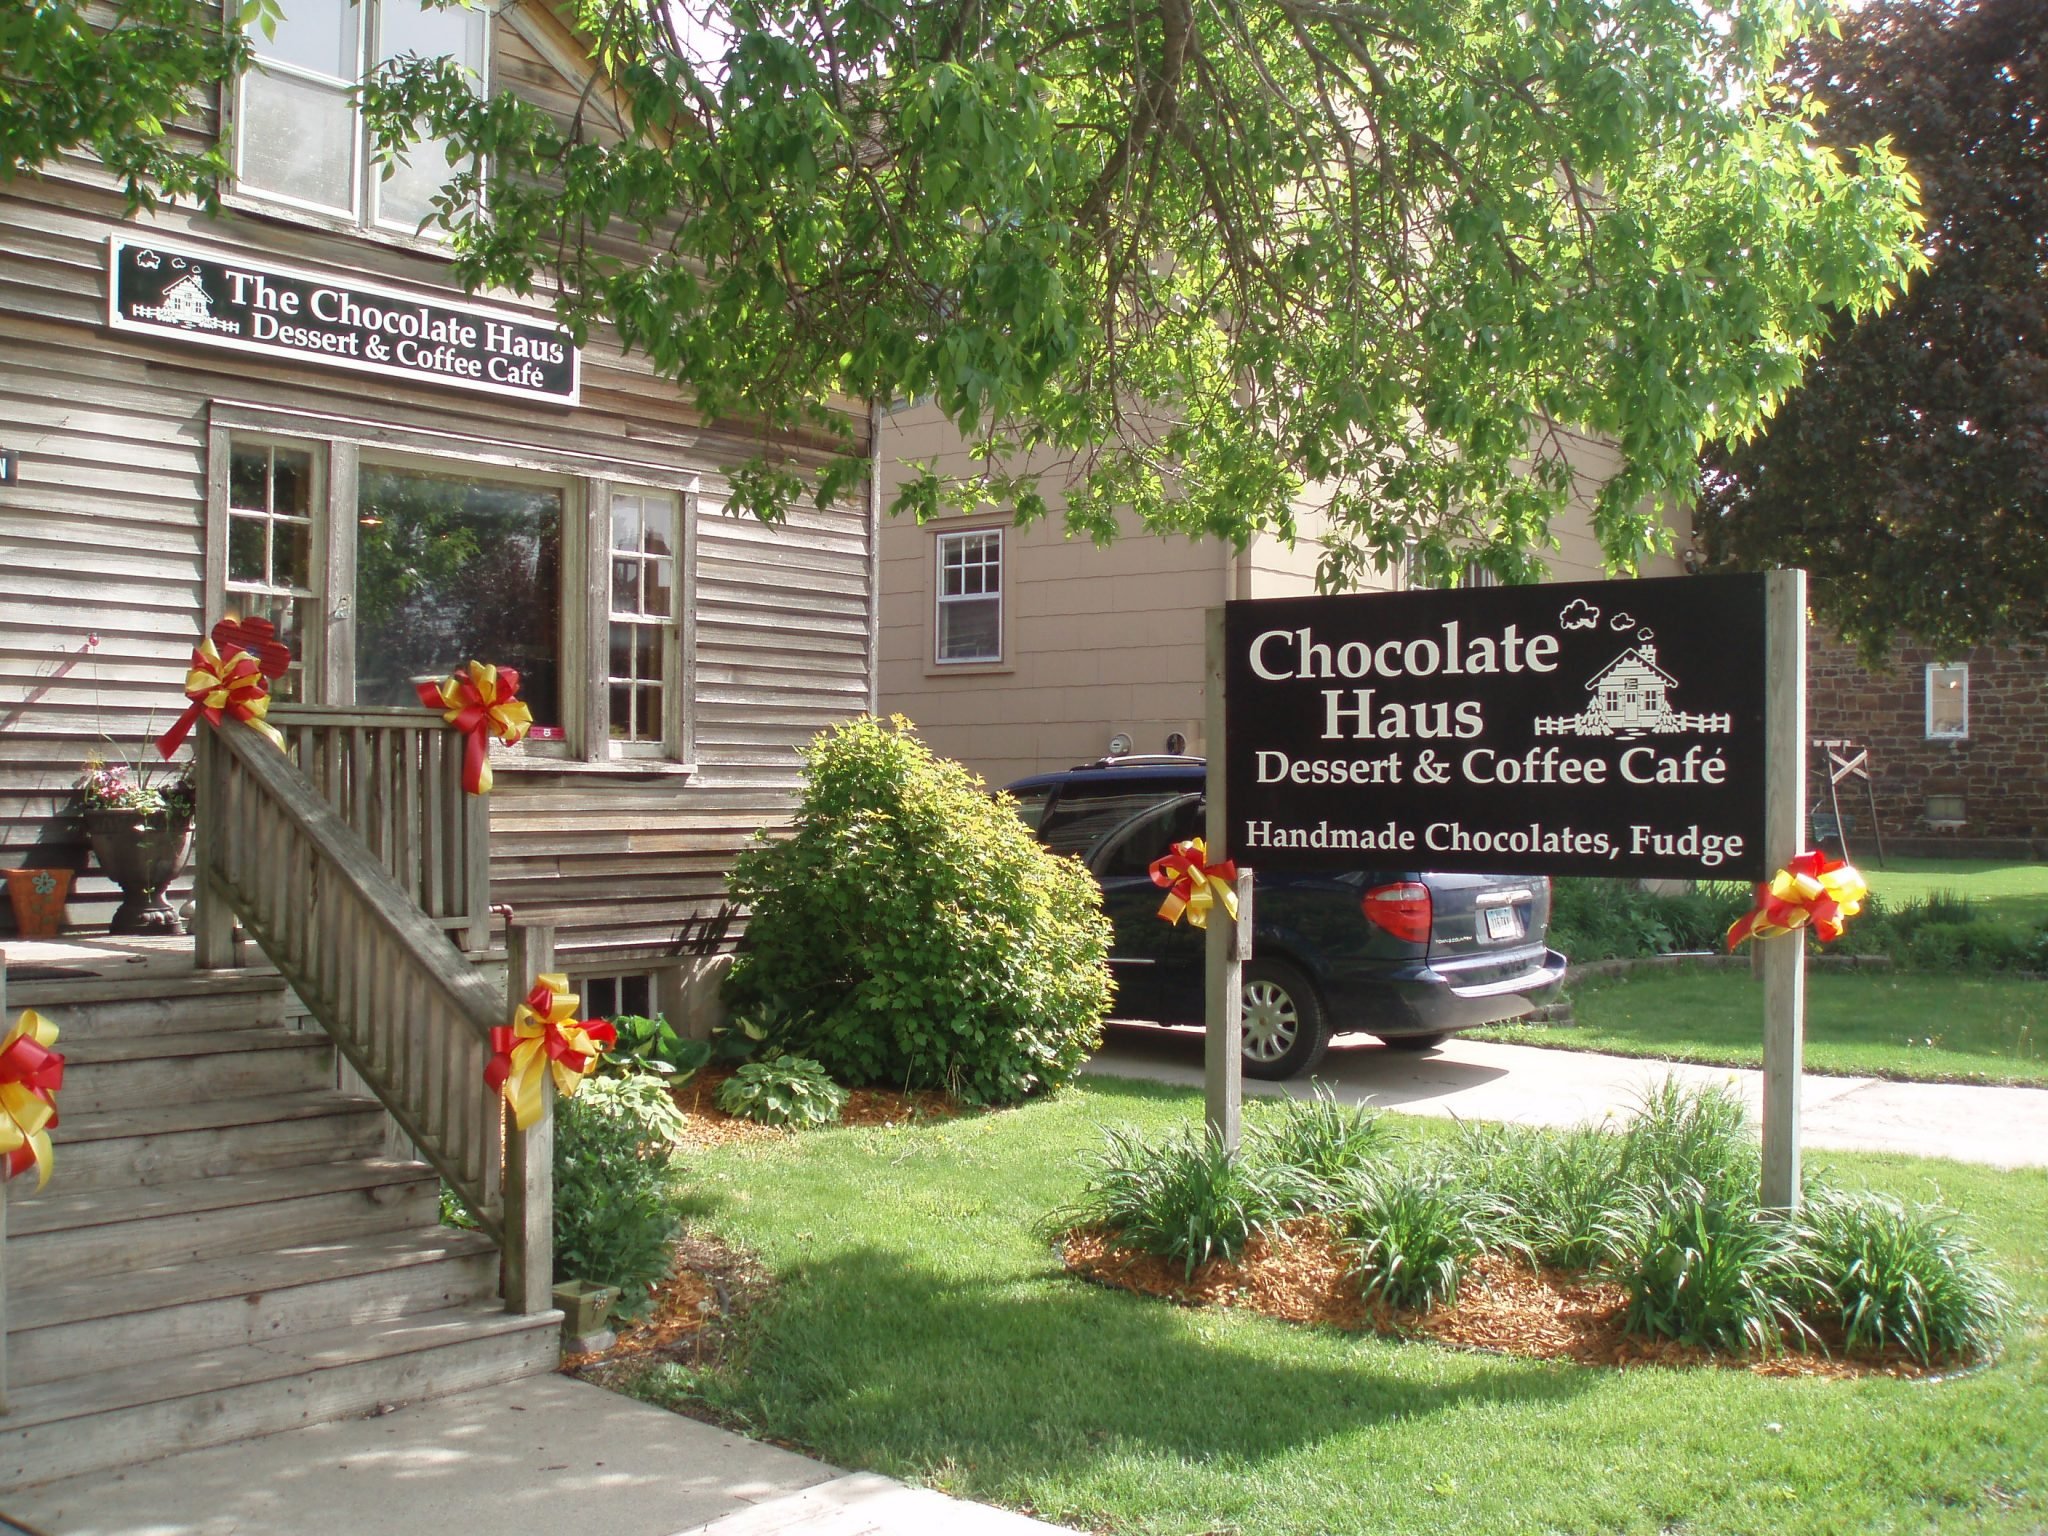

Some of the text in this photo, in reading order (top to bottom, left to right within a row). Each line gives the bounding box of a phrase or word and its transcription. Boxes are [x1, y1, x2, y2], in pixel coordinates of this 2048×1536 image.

[226, 270, 565, 365] The Chocolate Haus
[252, 312, 544, 388] Dessert & Coffee Café
[1249, 621, 1559, 681] Chocolate
[1320, 689, 1484, 739] Haus
[1256, 746, 1726, 784] Dessert & Coffee Café
[1246, 820, 1744, 866] Handmade Chocolates, Fudge
